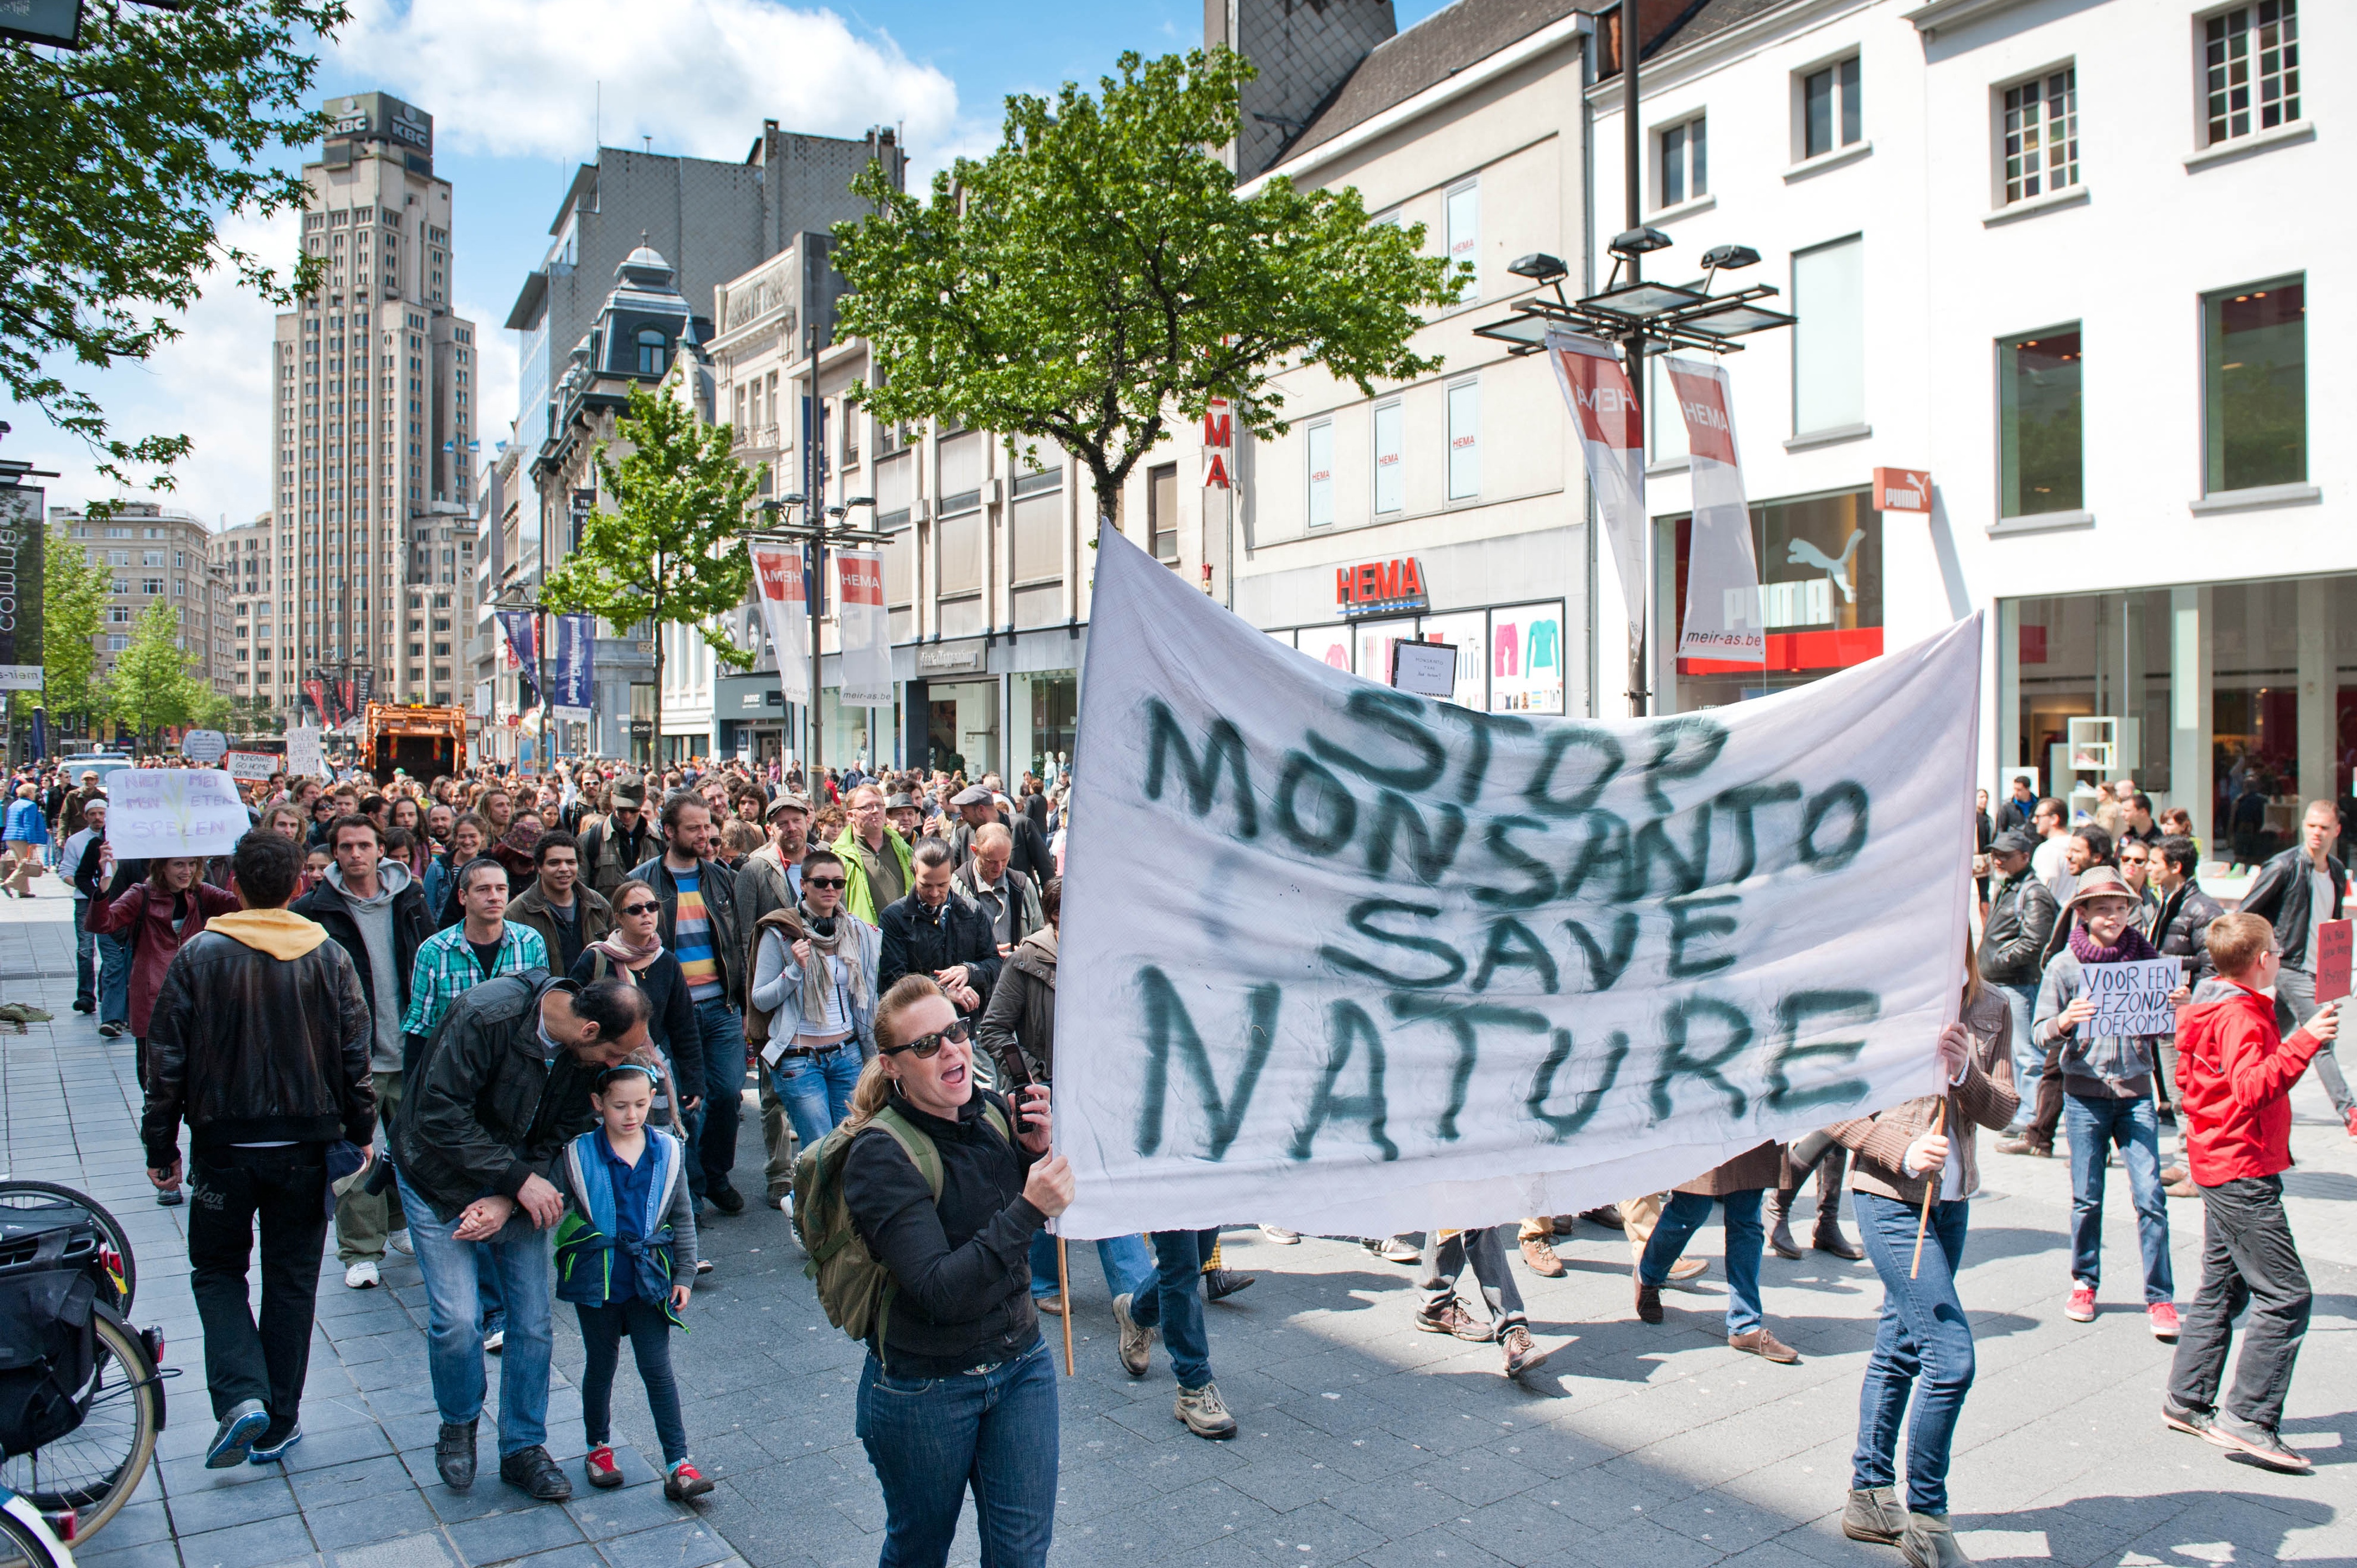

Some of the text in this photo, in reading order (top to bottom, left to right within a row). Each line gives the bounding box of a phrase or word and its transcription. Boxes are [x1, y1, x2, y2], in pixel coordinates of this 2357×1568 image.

[331, 117, 367, 135] KBC
[392, 121, 427, 147] KBC
[1452, 239, 1474, 251] HEMA
[1682, 401, 1730, 433] HEMA
[1453, 436, 1475, 447] HEMA
[1379, 453, 1399, 464] HEMA
[1312, 470, 1330, 481] HEMA
[1885, 487, 1921, 509] PUMA
[842, 574, 880, 589] HEMA
[1336, 556, 1422, 604] HEMA
[1723, 577, 1835, 631] PUMA
[1686, 630, 1761, 647] meir-as.be
[843, 691, 891, 700] meir-as.be
[235, 754, 273, 762] MONSANTO
[1305, 688, 1730, 815] STOP
[188, 773, 220, 788] MET
[191, 795, 238, 807] ETEN
[1141, 695, 1871, 908] MONSANTO
[131, 820, 225, 838] SPELEN
[1318, 893, 1743, 994] SAVE
[2083, 963, 2176, 993] VOOR EEN
[2087, 989, 2177, 1016] GEZONDE
[2088, 1011, 2176, 1038] TOEKOMST
[1134, 965, 1883, 1163] NATURE
